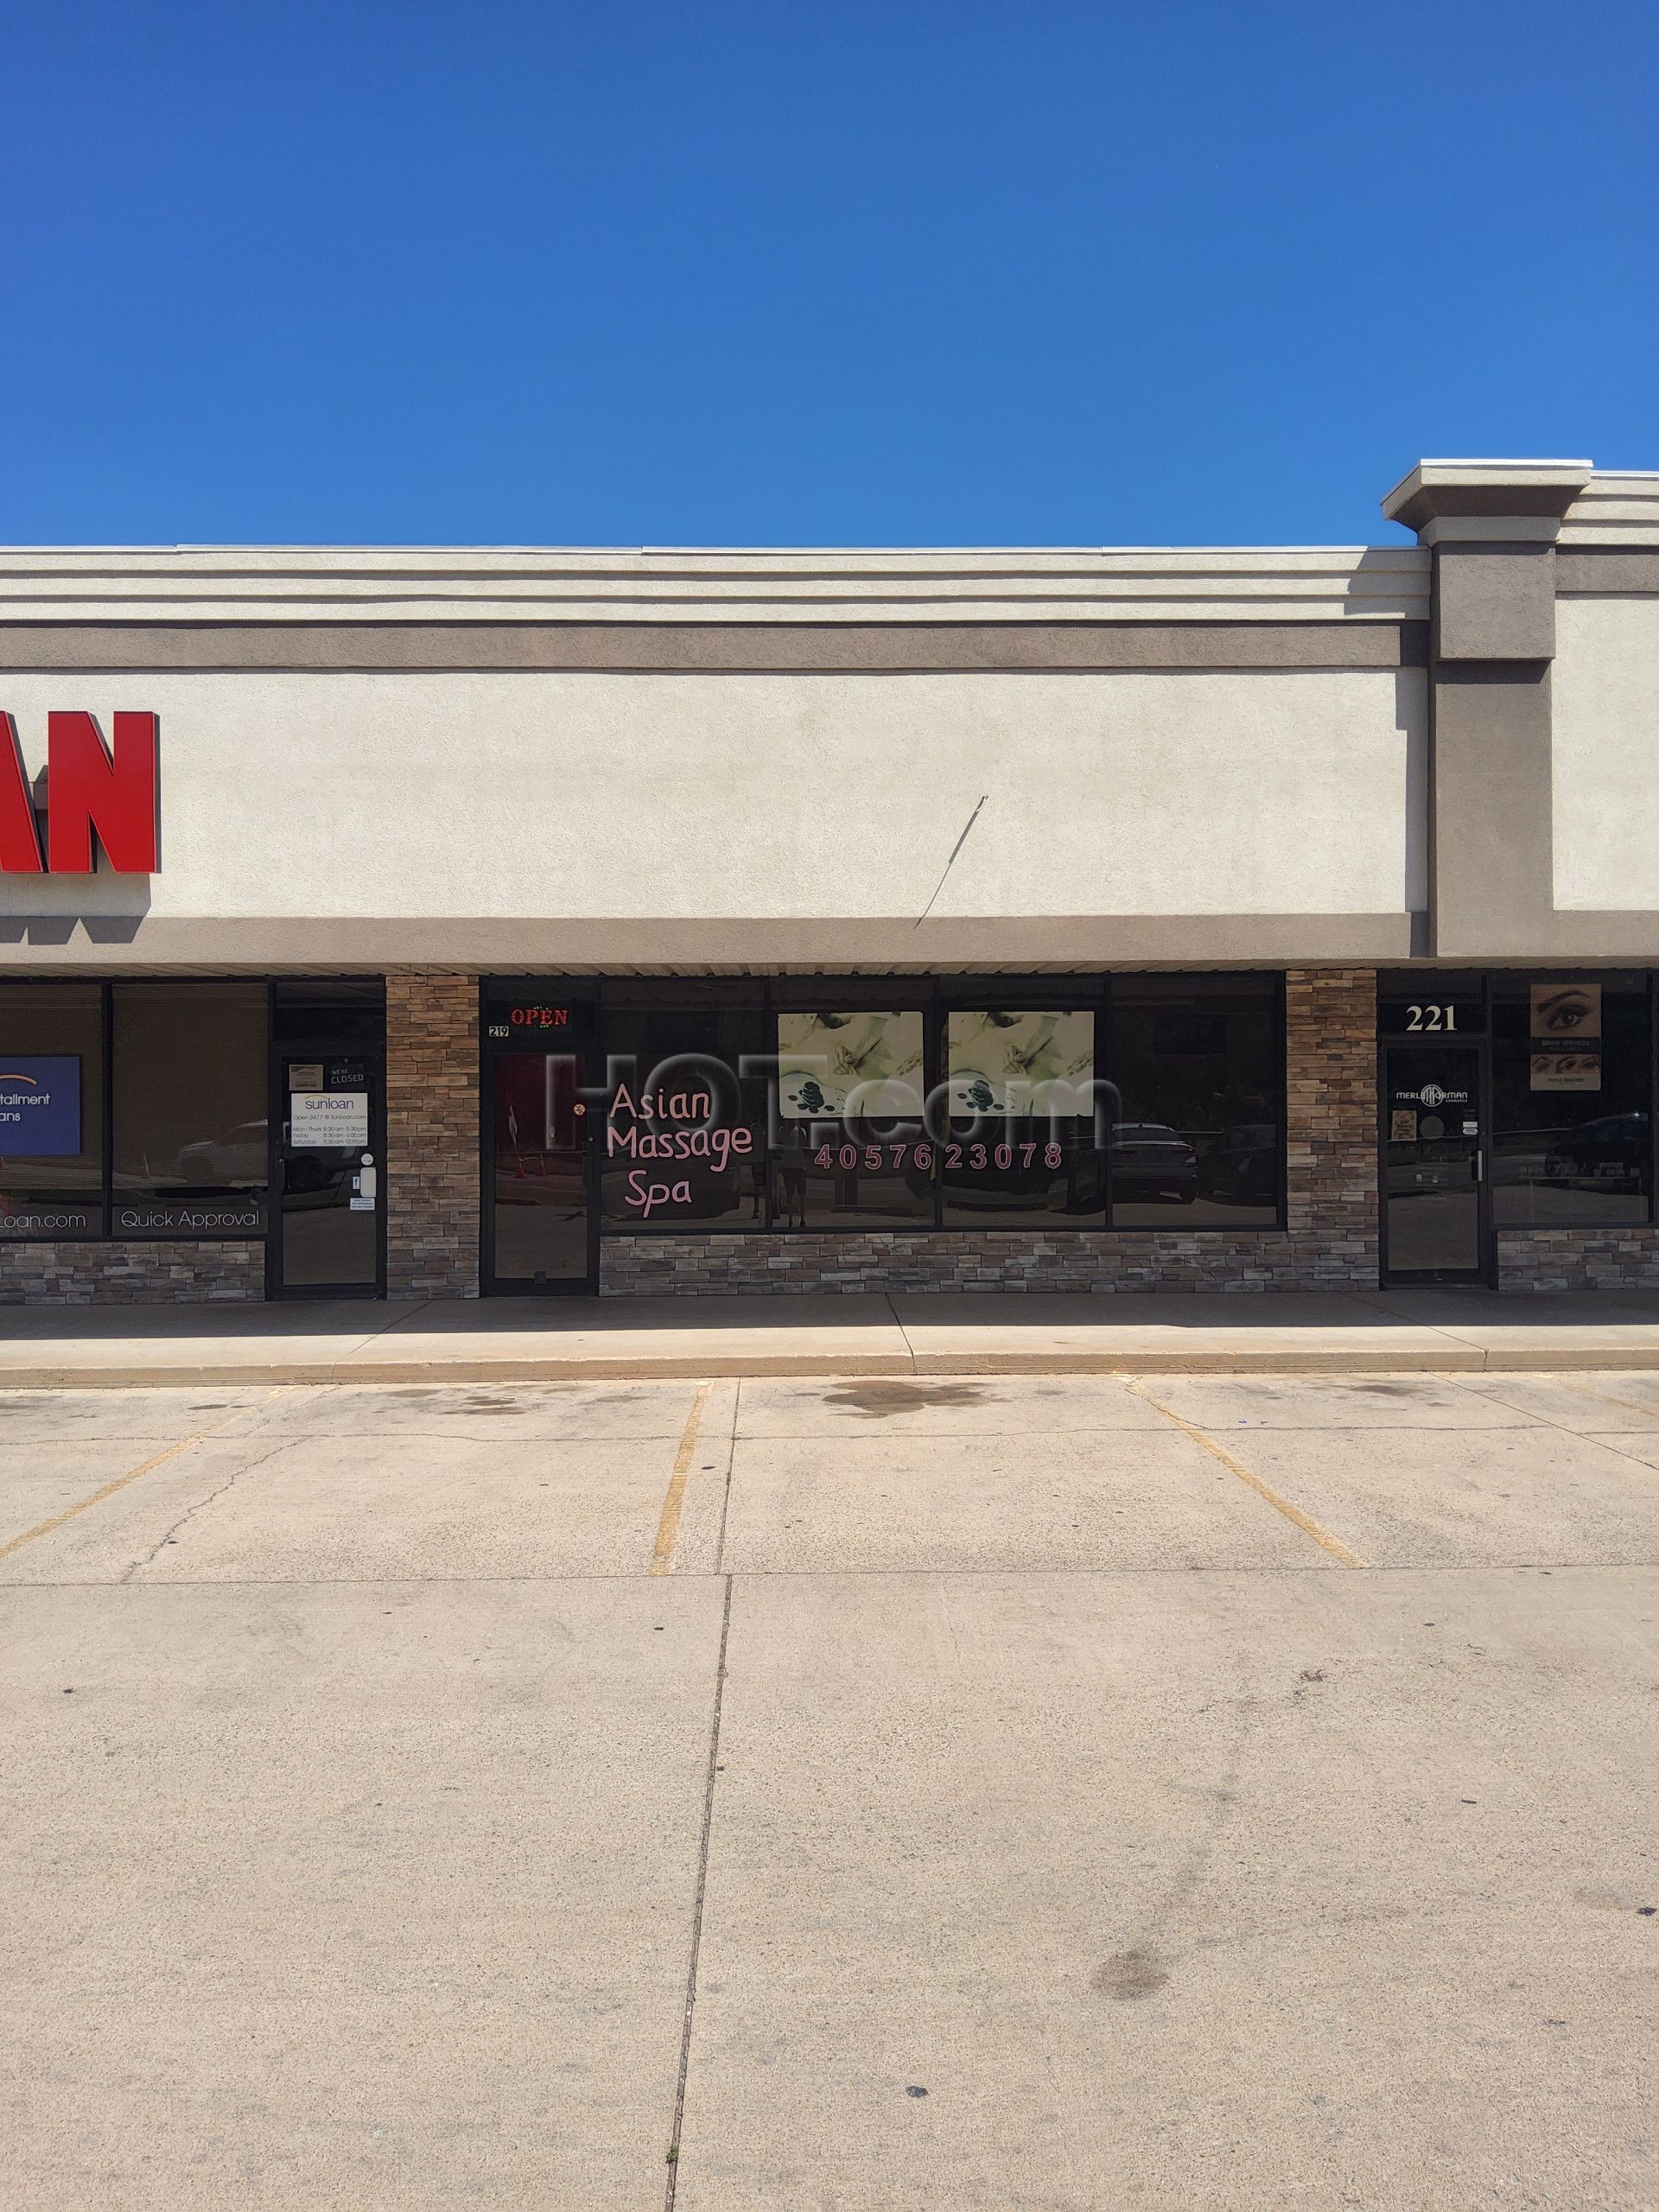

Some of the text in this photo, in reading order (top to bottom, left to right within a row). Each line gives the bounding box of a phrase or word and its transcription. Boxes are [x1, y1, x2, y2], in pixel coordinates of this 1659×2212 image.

[511, 1008, 569, 1025] OPEN
[1405, 1005, 1459, 1031] 221
[490, 1027, 508, 1036] 219
[331, 1074, 364, 1084] CLOSED
[305, 1097, 354, 1109] sunloan
[608, 1082, 711, 1121] Asian
[607, 1123, 753, 1173] Massage
[625, 1171, 691, 1218] Spa
[0, 1214, 86, 1228] oan.com
[120, 1210, 260, 1230] Quick Approval
